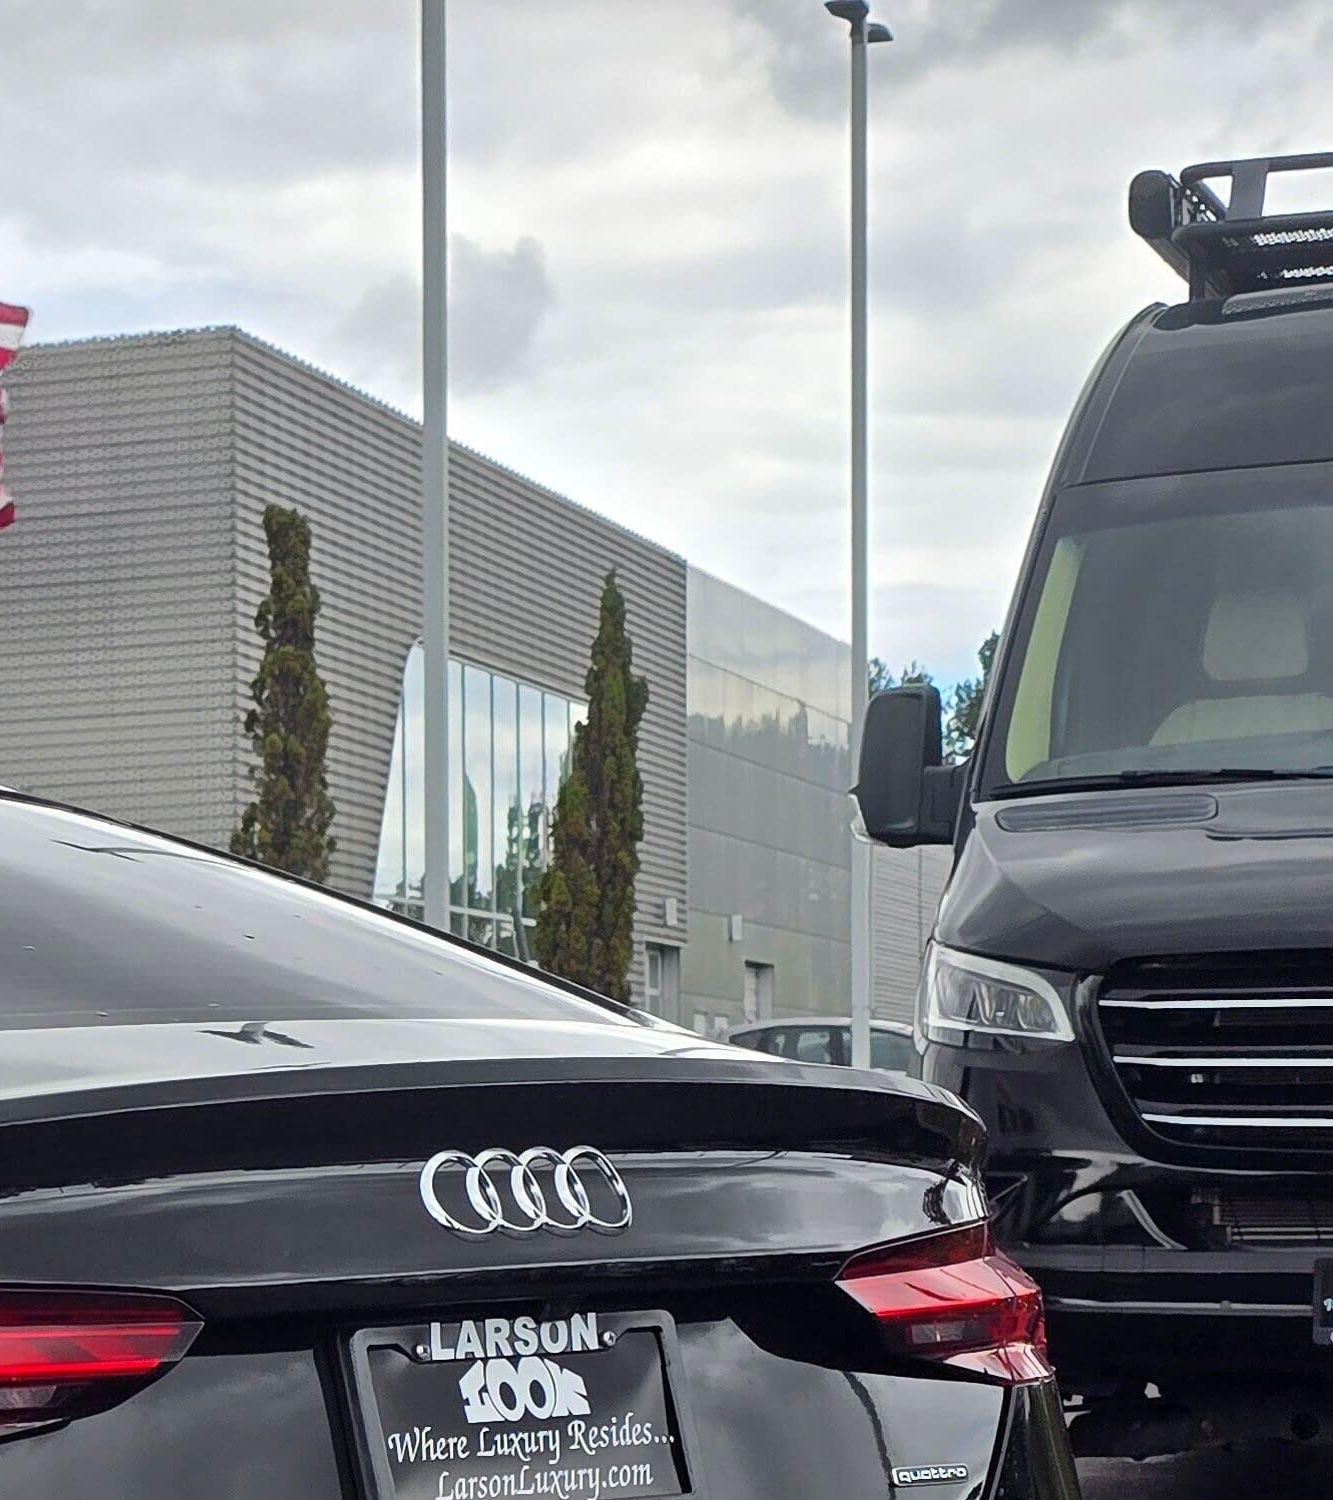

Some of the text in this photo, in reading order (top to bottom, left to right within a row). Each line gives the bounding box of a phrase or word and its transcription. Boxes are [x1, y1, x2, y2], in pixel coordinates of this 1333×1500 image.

[430, 1312, 600, 1361] LARSON
[388, 1412, 676, 1464] Where Luxury Resides...
[435, 1463, 654, 1500] LarsonLuxury.com
[898, 1467, 967, 1483] quattro
